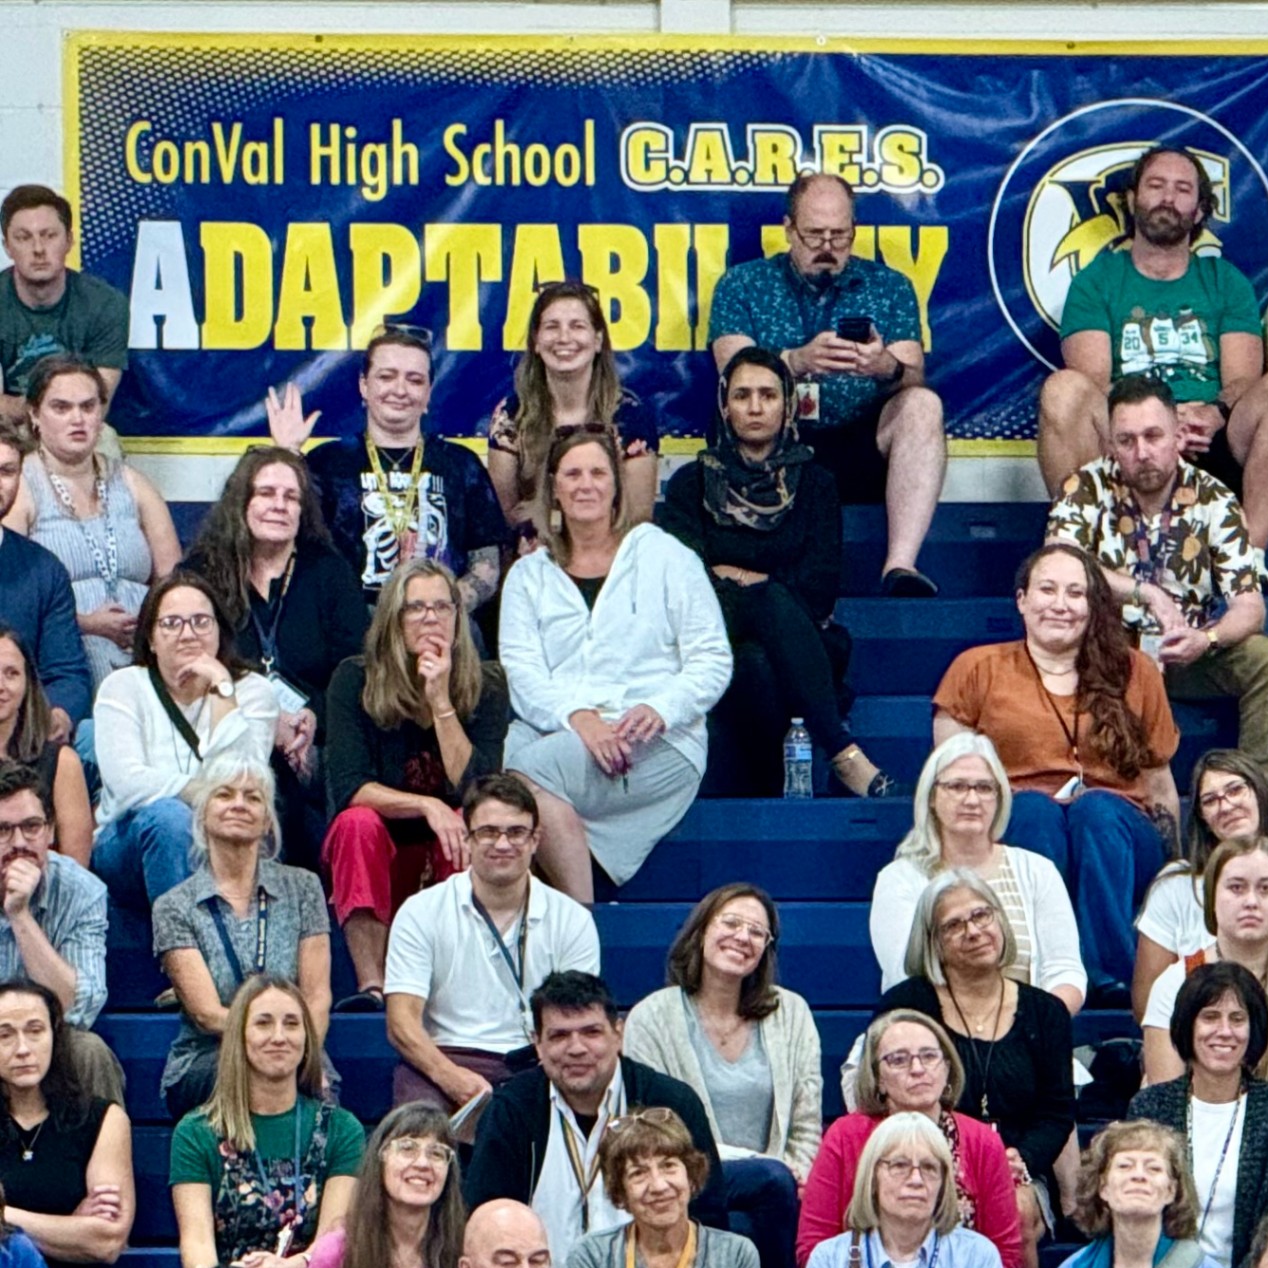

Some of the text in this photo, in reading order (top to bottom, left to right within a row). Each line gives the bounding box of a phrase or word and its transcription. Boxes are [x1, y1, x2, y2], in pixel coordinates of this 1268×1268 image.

[125, 117, 945, 202] ConVal High School C.A.R.E.S.
[127, 219, 949, 353] ADAPTABILY
[1124, 337, 1140, 351] 20
[1158, 332, 1169, 345] 5
[1181, 332, 1199, 345] 34
